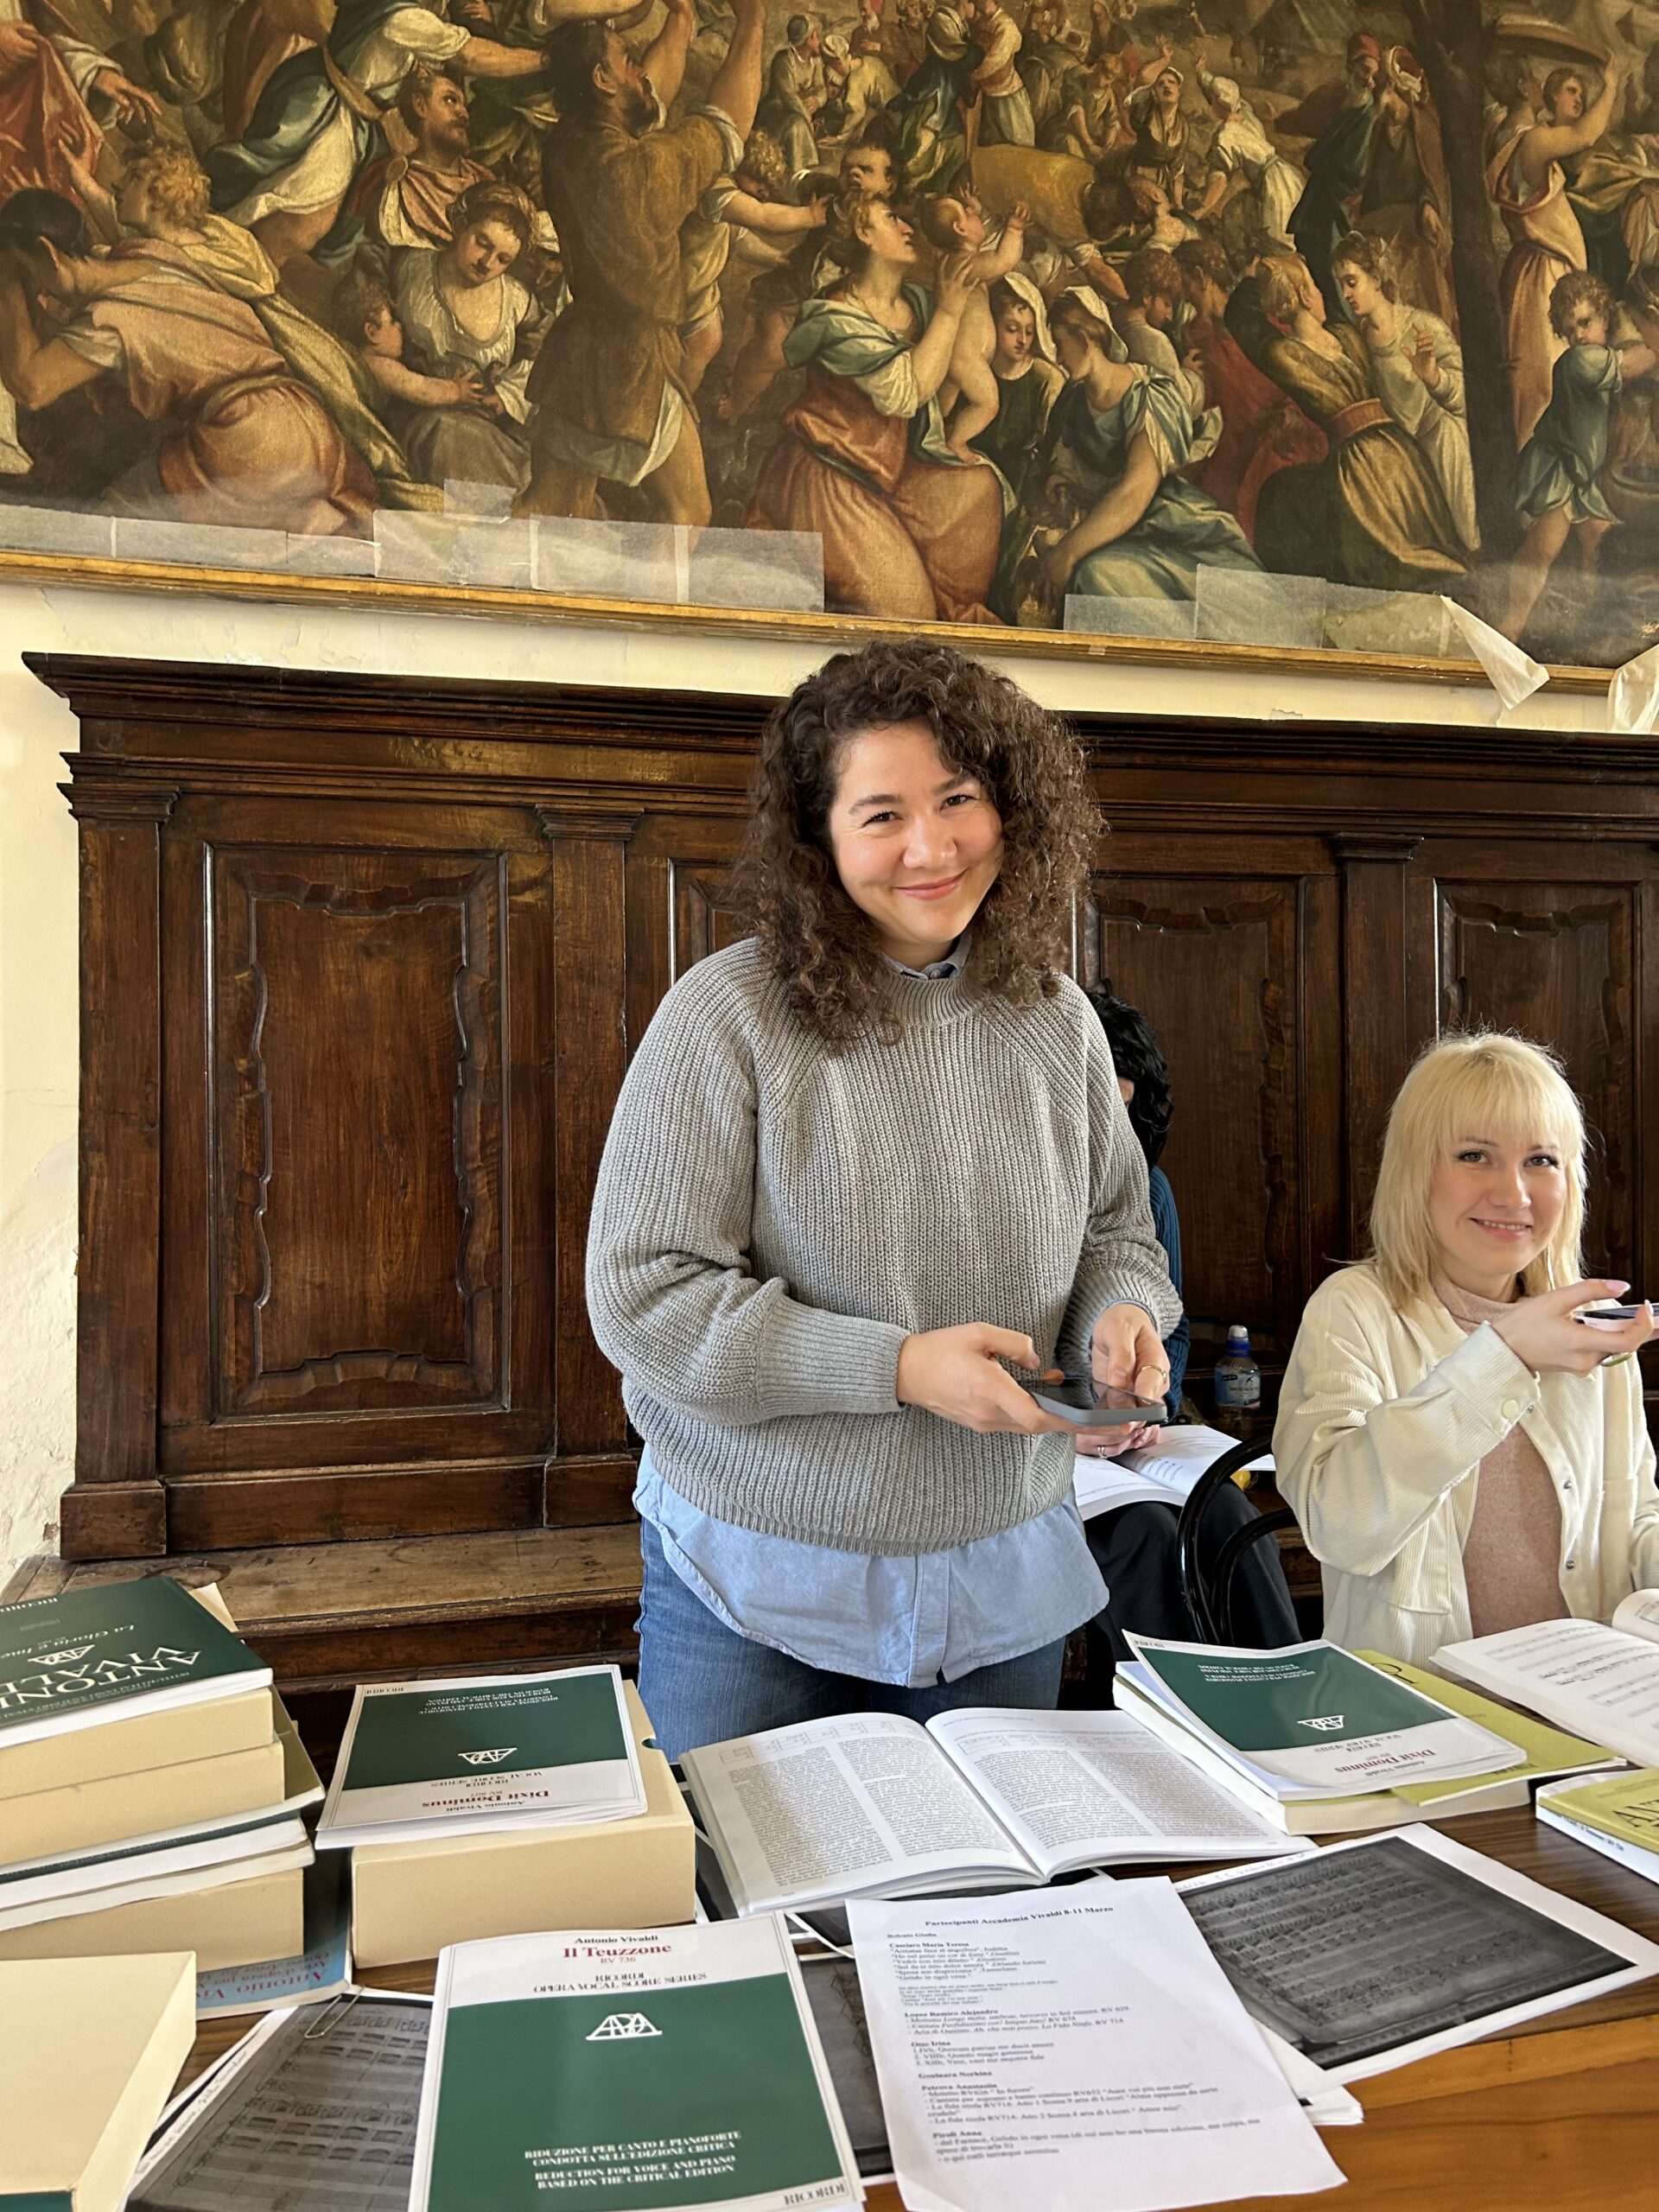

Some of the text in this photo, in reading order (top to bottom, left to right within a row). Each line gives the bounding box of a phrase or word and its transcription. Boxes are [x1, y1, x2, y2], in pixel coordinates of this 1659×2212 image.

[54, 1630, 109, 1647] Gloria
[1334, 1749, 1436, 1773] Dixit Dominus
[422, 1789, 550, 1808] Dixit Dominus
[1030, 1910, 1062, 1919] Vivaldi
[575, 1935, 658, 1944] Antonio Vivaldi
[563, 1944, 672, 1958] Il Teuzzone
[236, 1968, 328, 1995] Antonio
[533, 1973, 707, 1993] OPERA VOCAL SCORE SERIES
[596, 1972, 645, 1982] RICORDI
[524, 2130, 741, 2159] RIDUZIONE PER CANTO E PIANOFORTE
[533, 2140, 735, 2167] CONDOTTA SULL'EDIZIONE CRITICA
[535, 2155, 736, 2181] REDUCTION FOR VOICE AND PIANO
[537, 2164, 734, 2190] BASED ON THE CRITICAL EDITION
[784, 2182, 846, 2206] RICORDI
